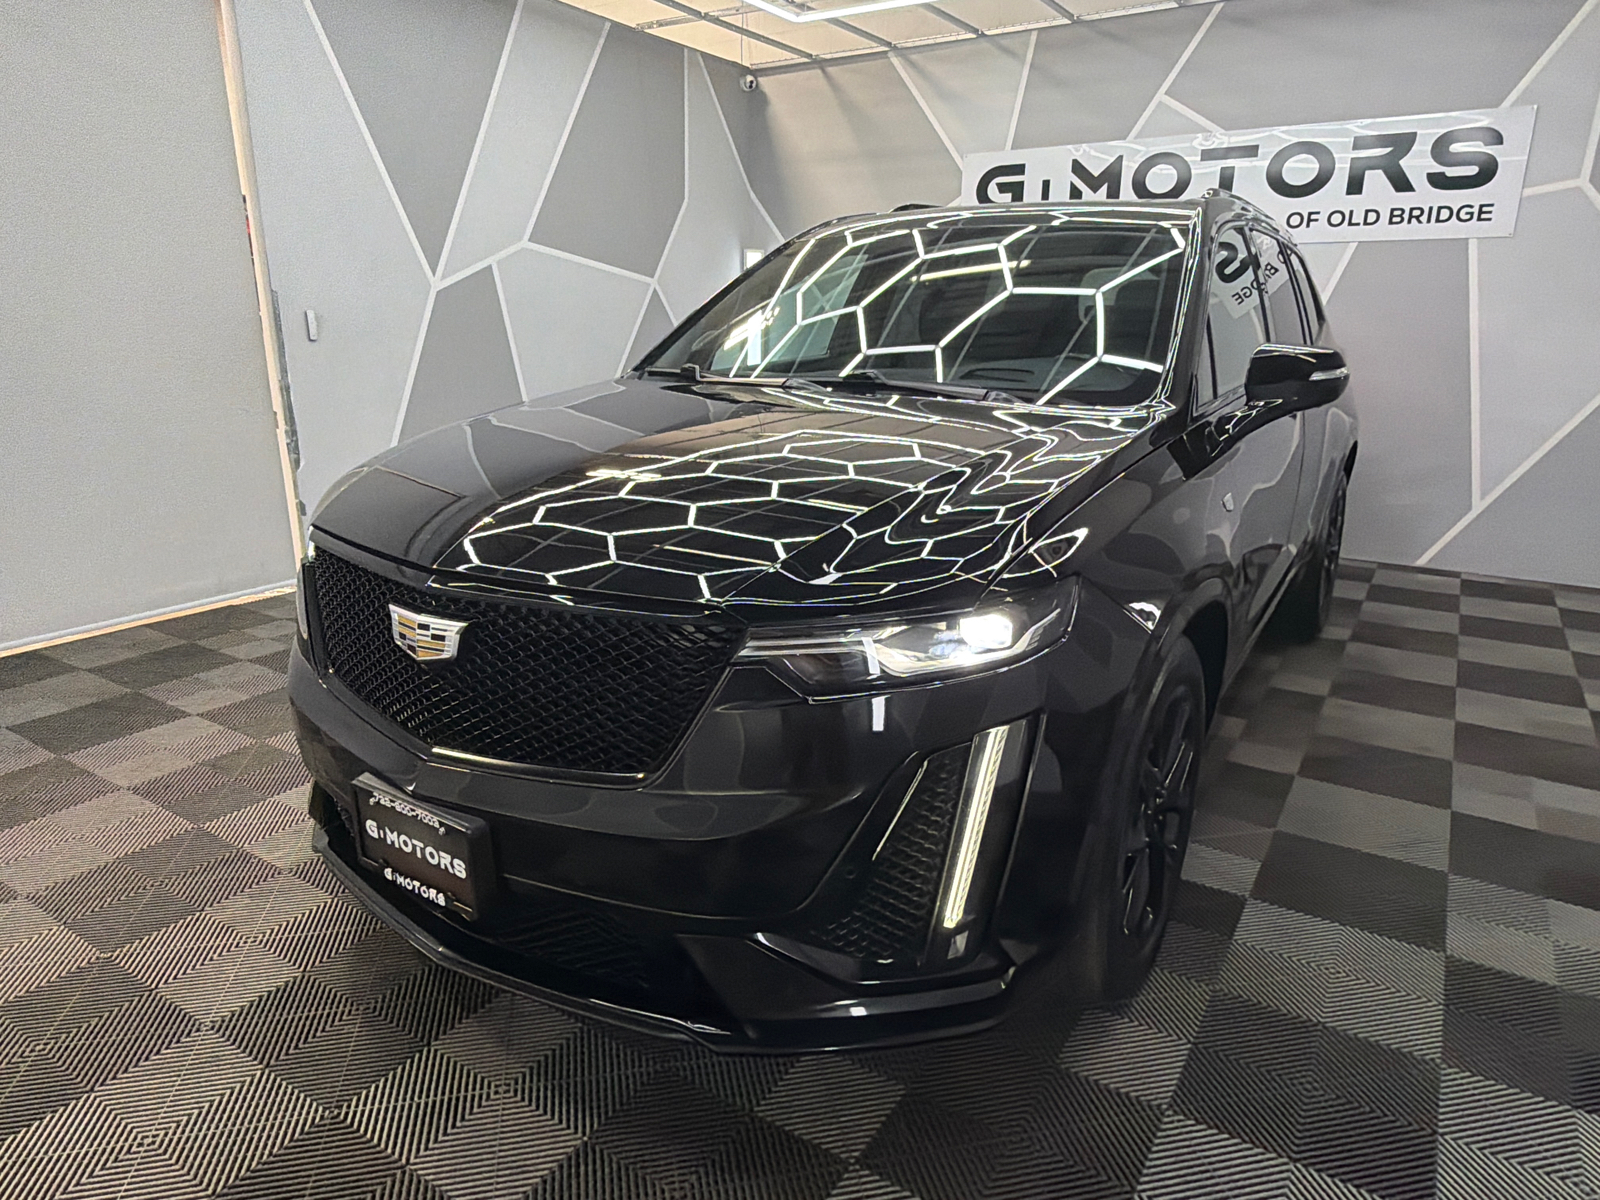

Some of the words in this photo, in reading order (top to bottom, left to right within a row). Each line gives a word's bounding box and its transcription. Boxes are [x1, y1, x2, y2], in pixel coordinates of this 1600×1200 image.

[1286, 211, 1321, 229] OF
[1326, 208, 1381, 228] OLD
[1388, 203, 1495, 225] BRIDGE
